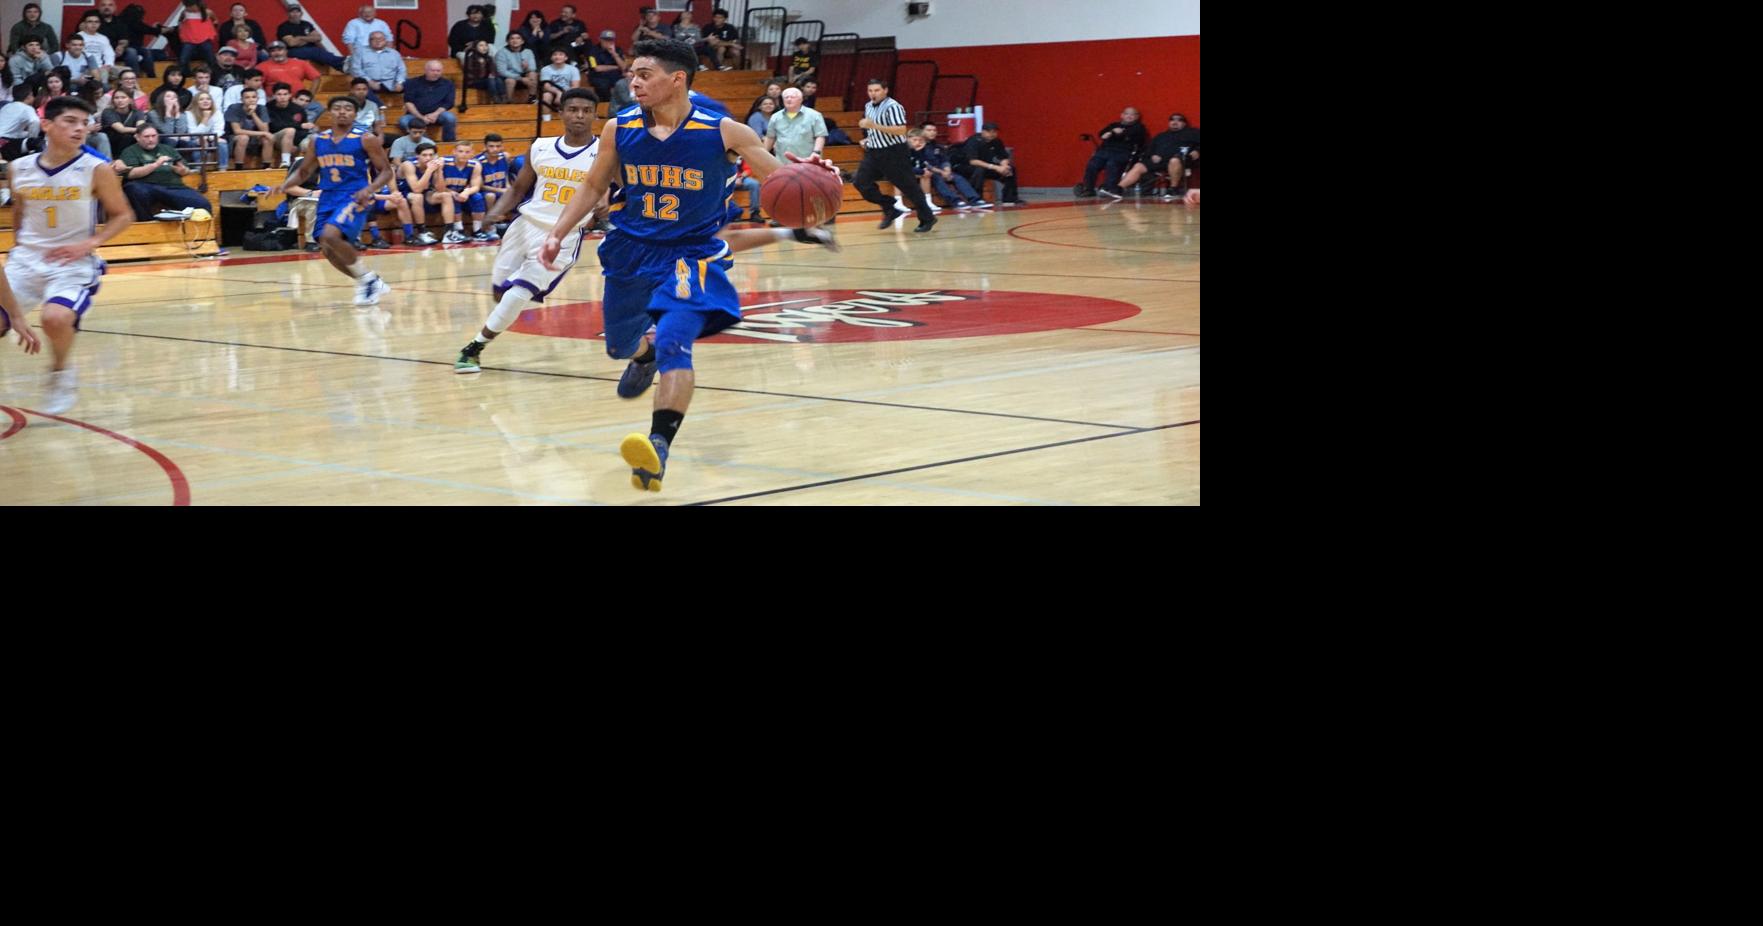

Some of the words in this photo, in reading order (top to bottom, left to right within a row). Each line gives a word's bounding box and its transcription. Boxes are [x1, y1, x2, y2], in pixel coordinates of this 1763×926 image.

[624, 164, 703, 190] BUHS
[543, 182, 576, 205] 20
[43, 206, 56, 229] 1
[642, 192, 680, 220] 12
